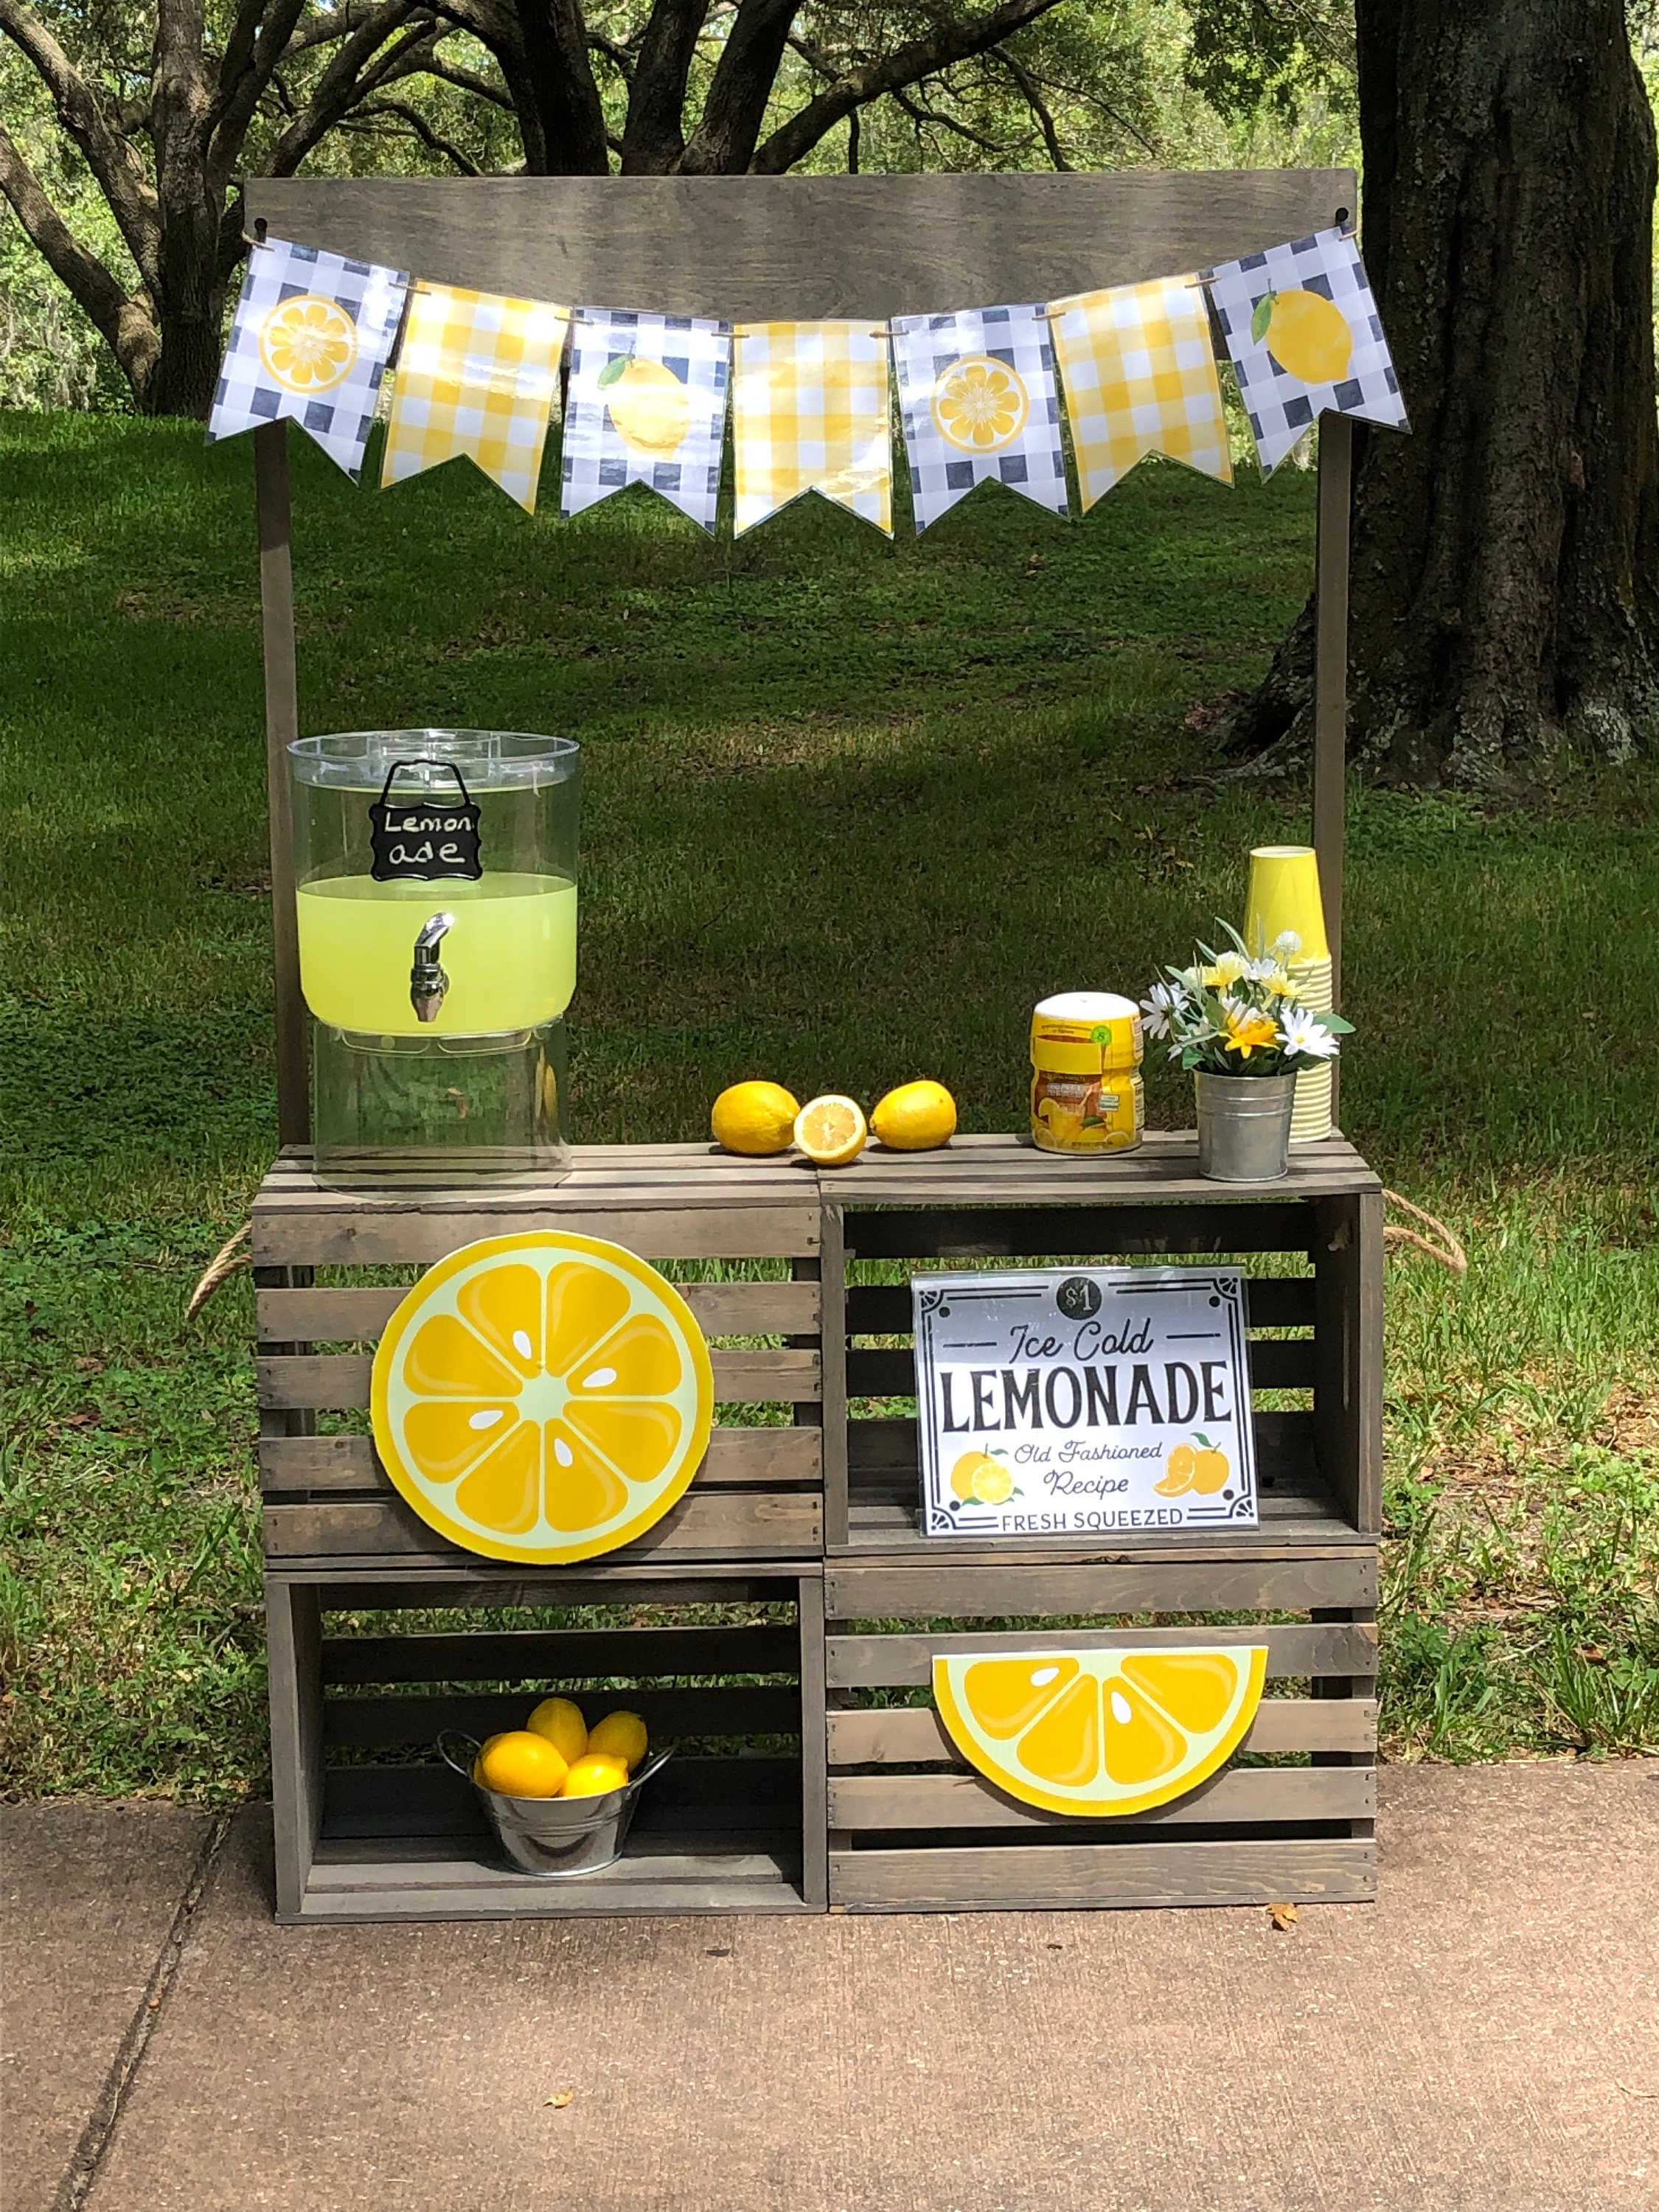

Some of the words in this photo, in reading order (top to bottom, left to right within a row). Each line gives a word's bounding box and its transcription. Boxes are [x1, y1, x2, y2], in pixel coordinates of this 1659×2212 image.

[384, 812, 471, 832] Lemon
[389, 841, 466, 864] ade
[1065, 1283, 1093, 1311] $1
[1009, 1324, 1063, 1364] Ice
[1074, 1317, 1155, 1361] Cold
[939, 1361, 1232, 1433] LEMONADE
[1014, 1444, 1052, 1464] Old
[1058, 1440, 1163, 1463] Fashioned
[1043, 1470, 1129, 1500] Recipe
[1002, 1513, 1067, 1531] FRESH
[1074, 1508, 1183, 1530] SQUEEZED
